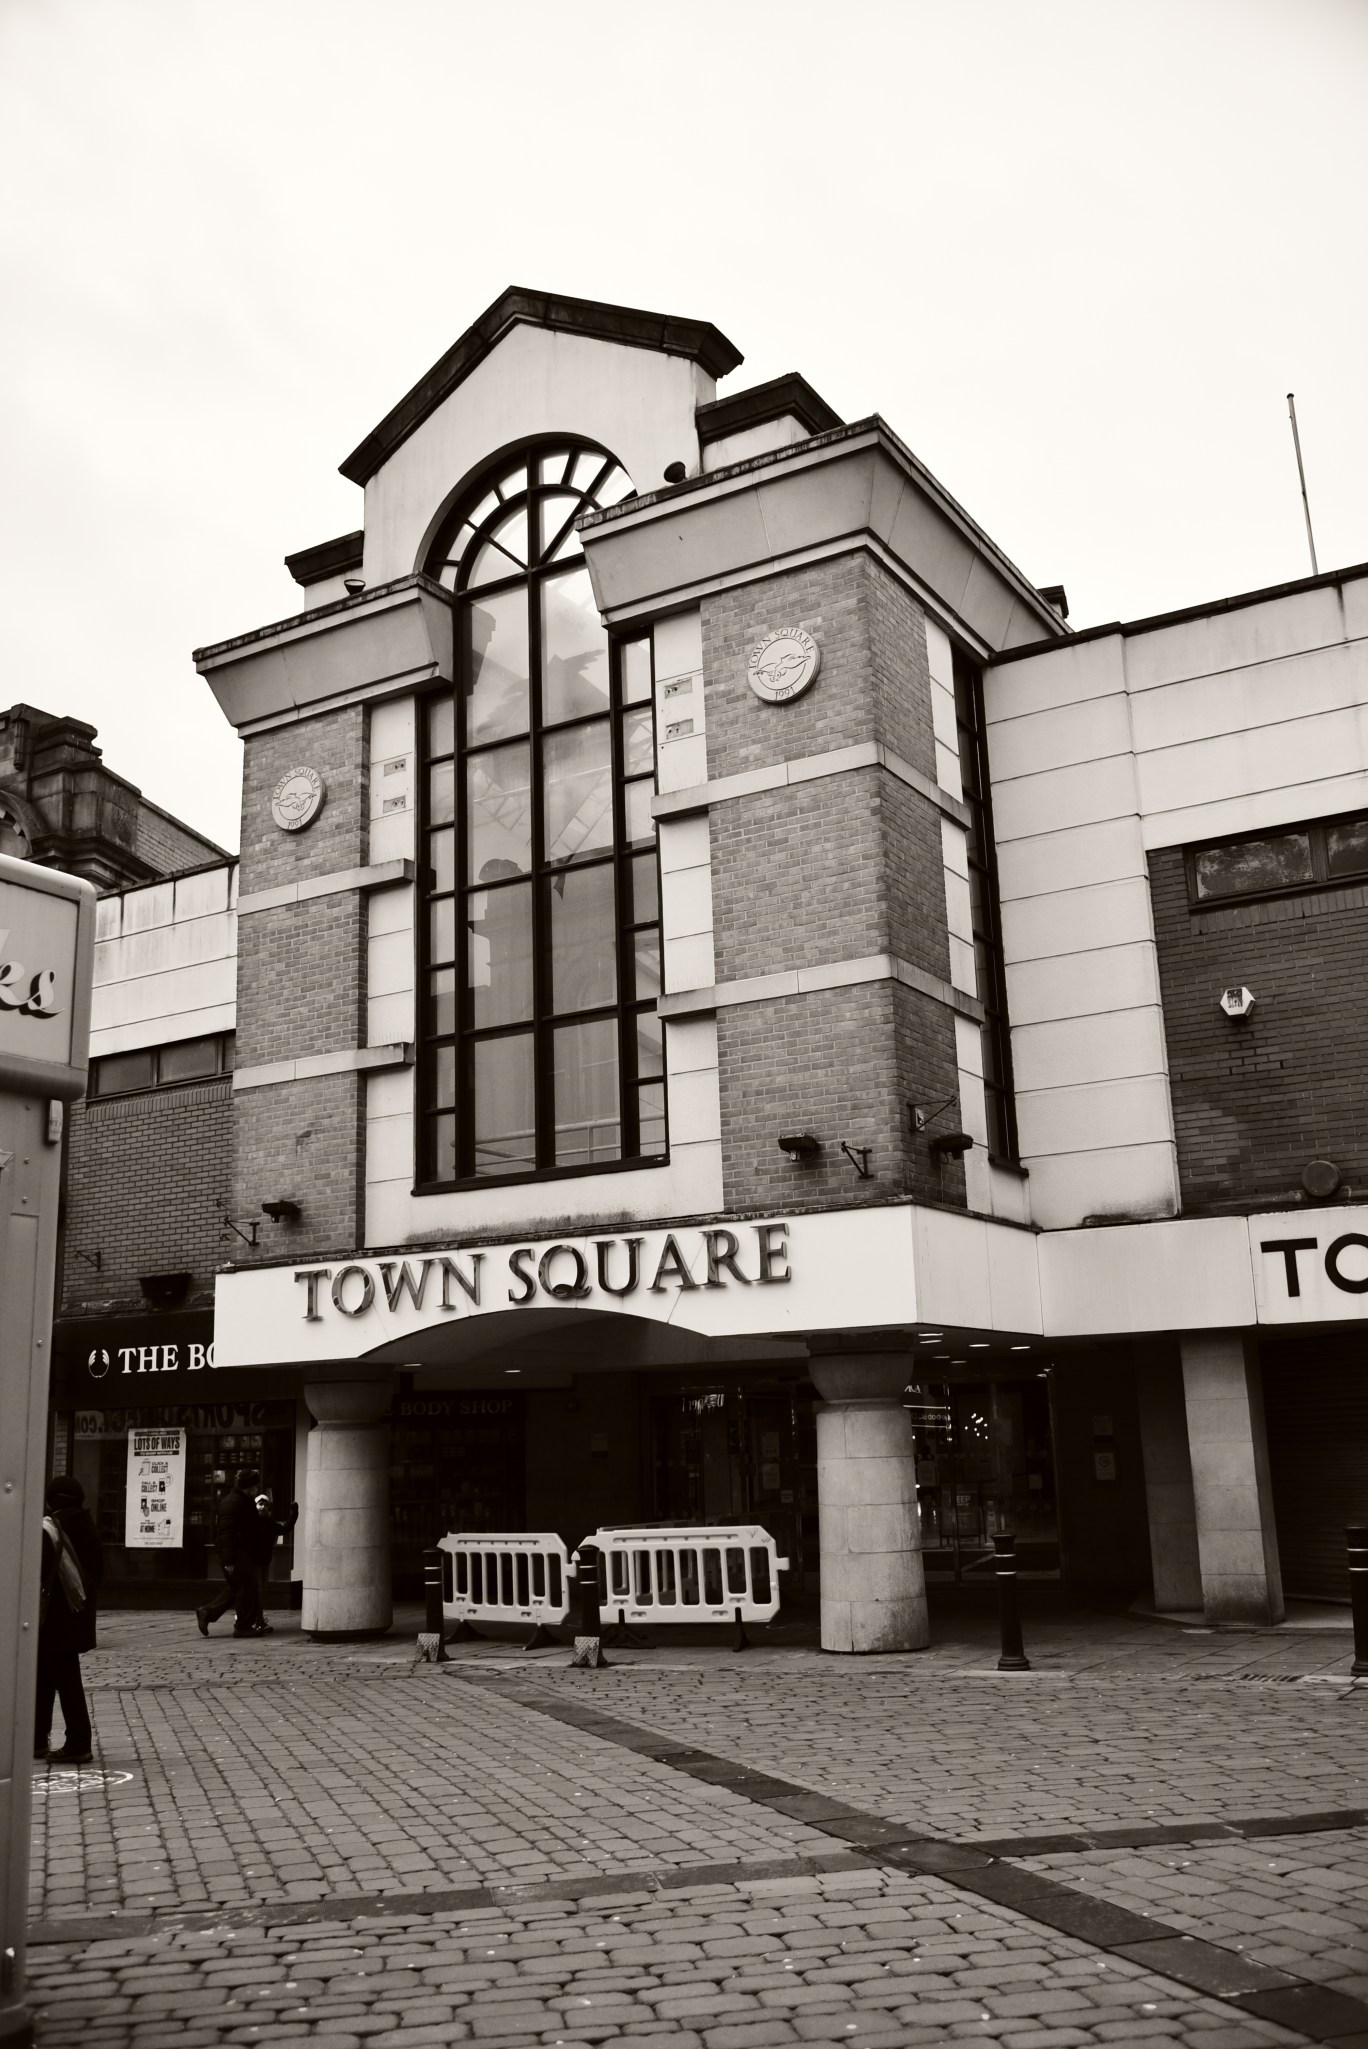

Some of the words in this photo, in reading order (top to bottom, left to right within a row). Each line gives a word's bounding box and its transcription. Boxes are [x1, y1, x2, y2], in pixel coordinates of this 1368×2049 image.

[749, 635, 771, 669] TOWN
[775, 628, 815, 654] SQUARE
[775, 686, 796, 701] 1991
[273, 772, 291, 800] TOWN
[287, 818, 303, 830] 1991
[293, 1253, 486, 1322] TOWN
[508, 1223, 794, 1305] SQUARE
[118, 1344, 178, 1374] THE
[399, 1400, 453, 1416] BODY
[460, 1399, 512, 1415] SHOP
[134, 1437, 150, 1451] LOTS
[151, 1436, 160, 1450] OF
[161, 1435, 180, 1450] WAYS
[151, 1465, 168, 1474] COLLECT
[141, 1484, 158, 1493] COLLECT
[151, 1502, 167, 1512] ONLINE
